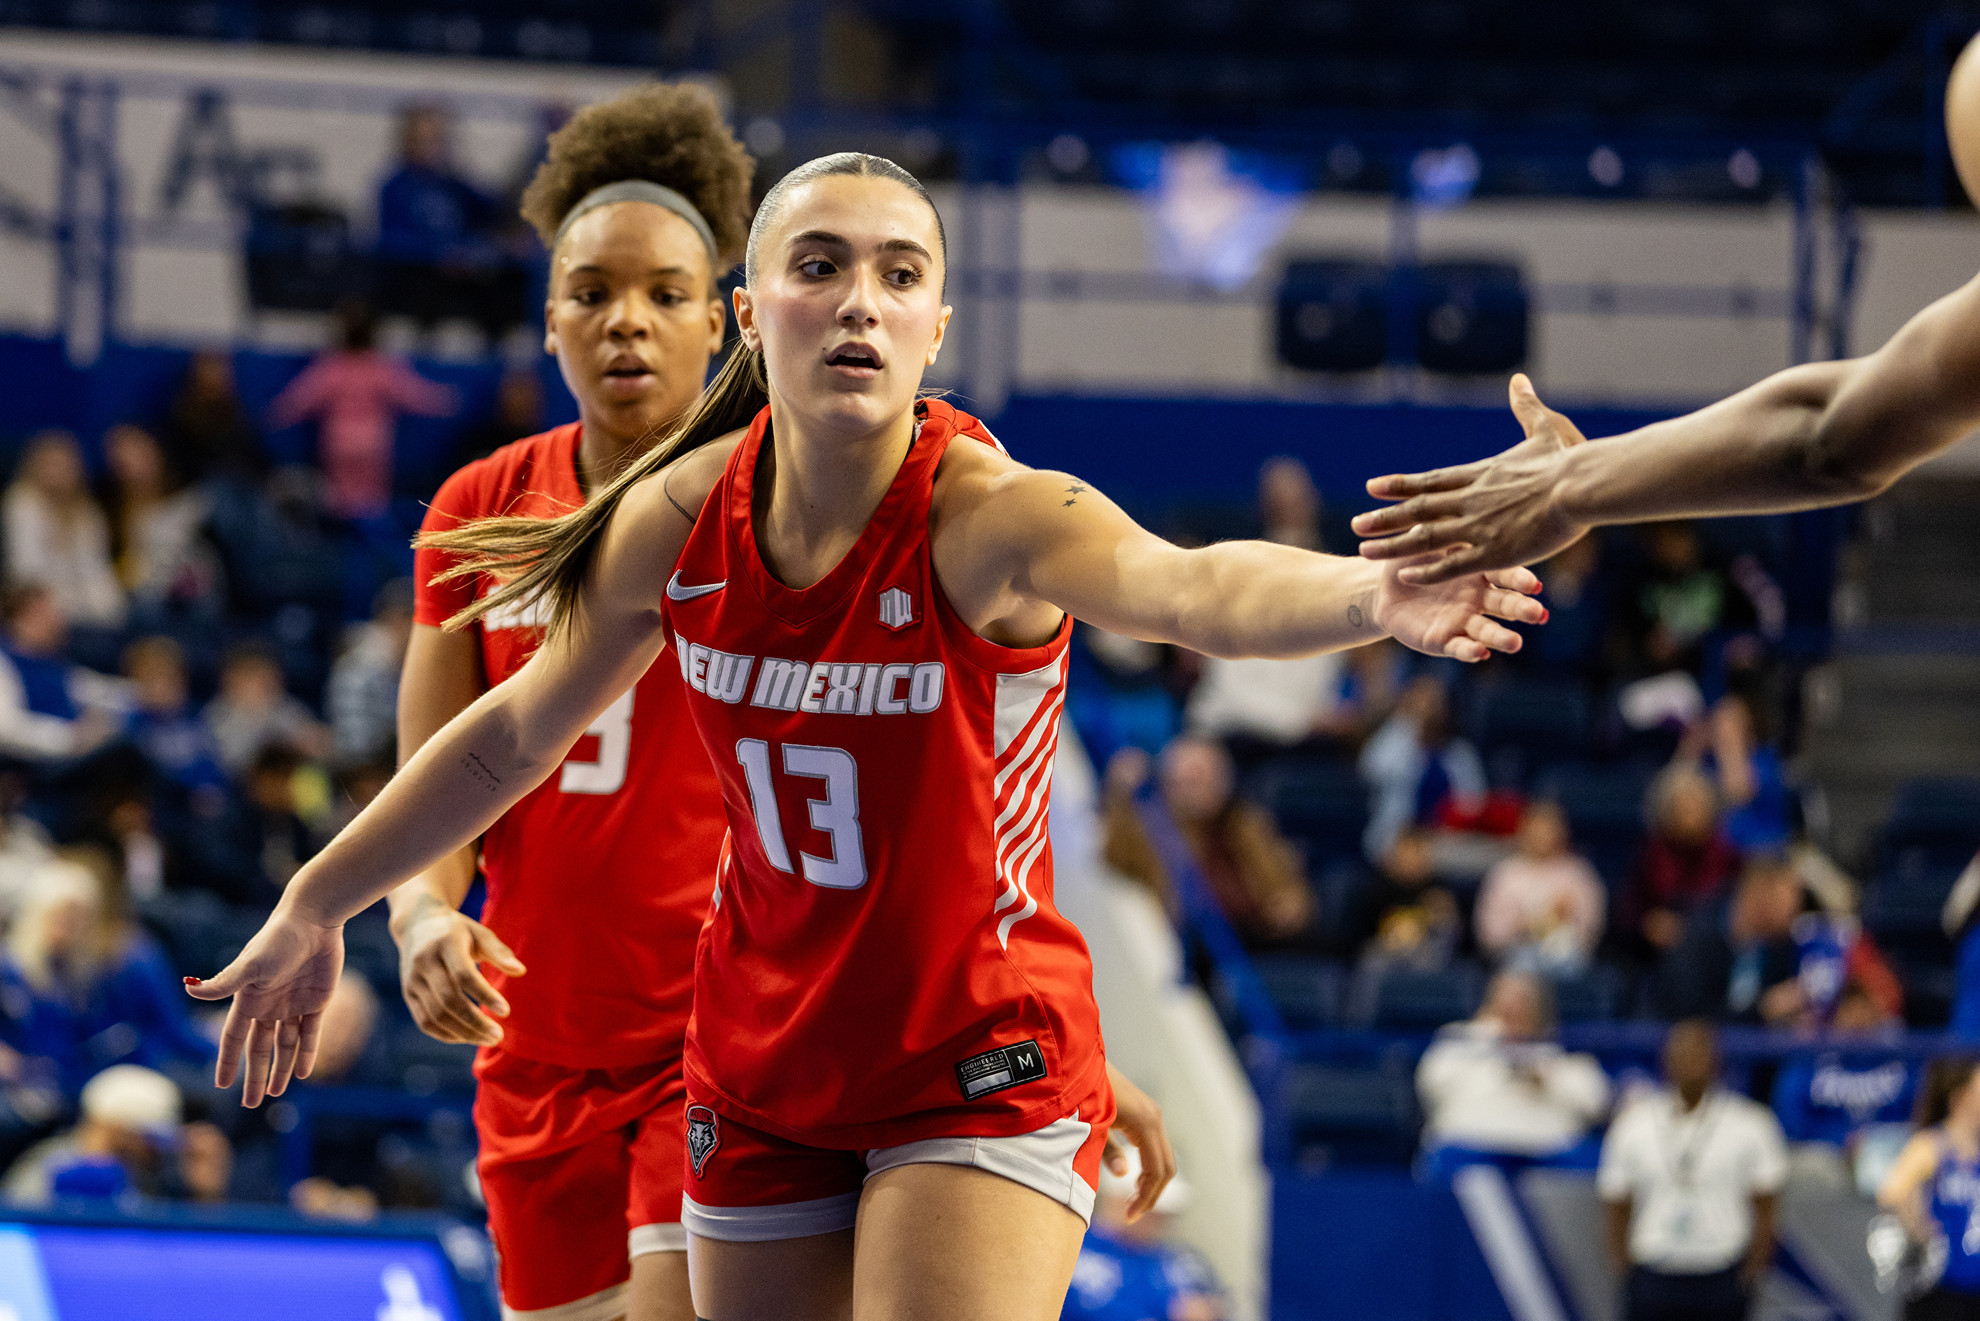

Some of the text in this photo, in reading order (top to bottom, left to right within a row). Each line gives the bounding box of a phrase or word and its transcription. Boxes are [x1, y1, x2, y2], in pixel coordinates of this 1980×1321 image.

[750, 657, 945, 716] MEXICO
[735, 737, 868, 890] 13
[1017, 1053, 1034, 1071] M
